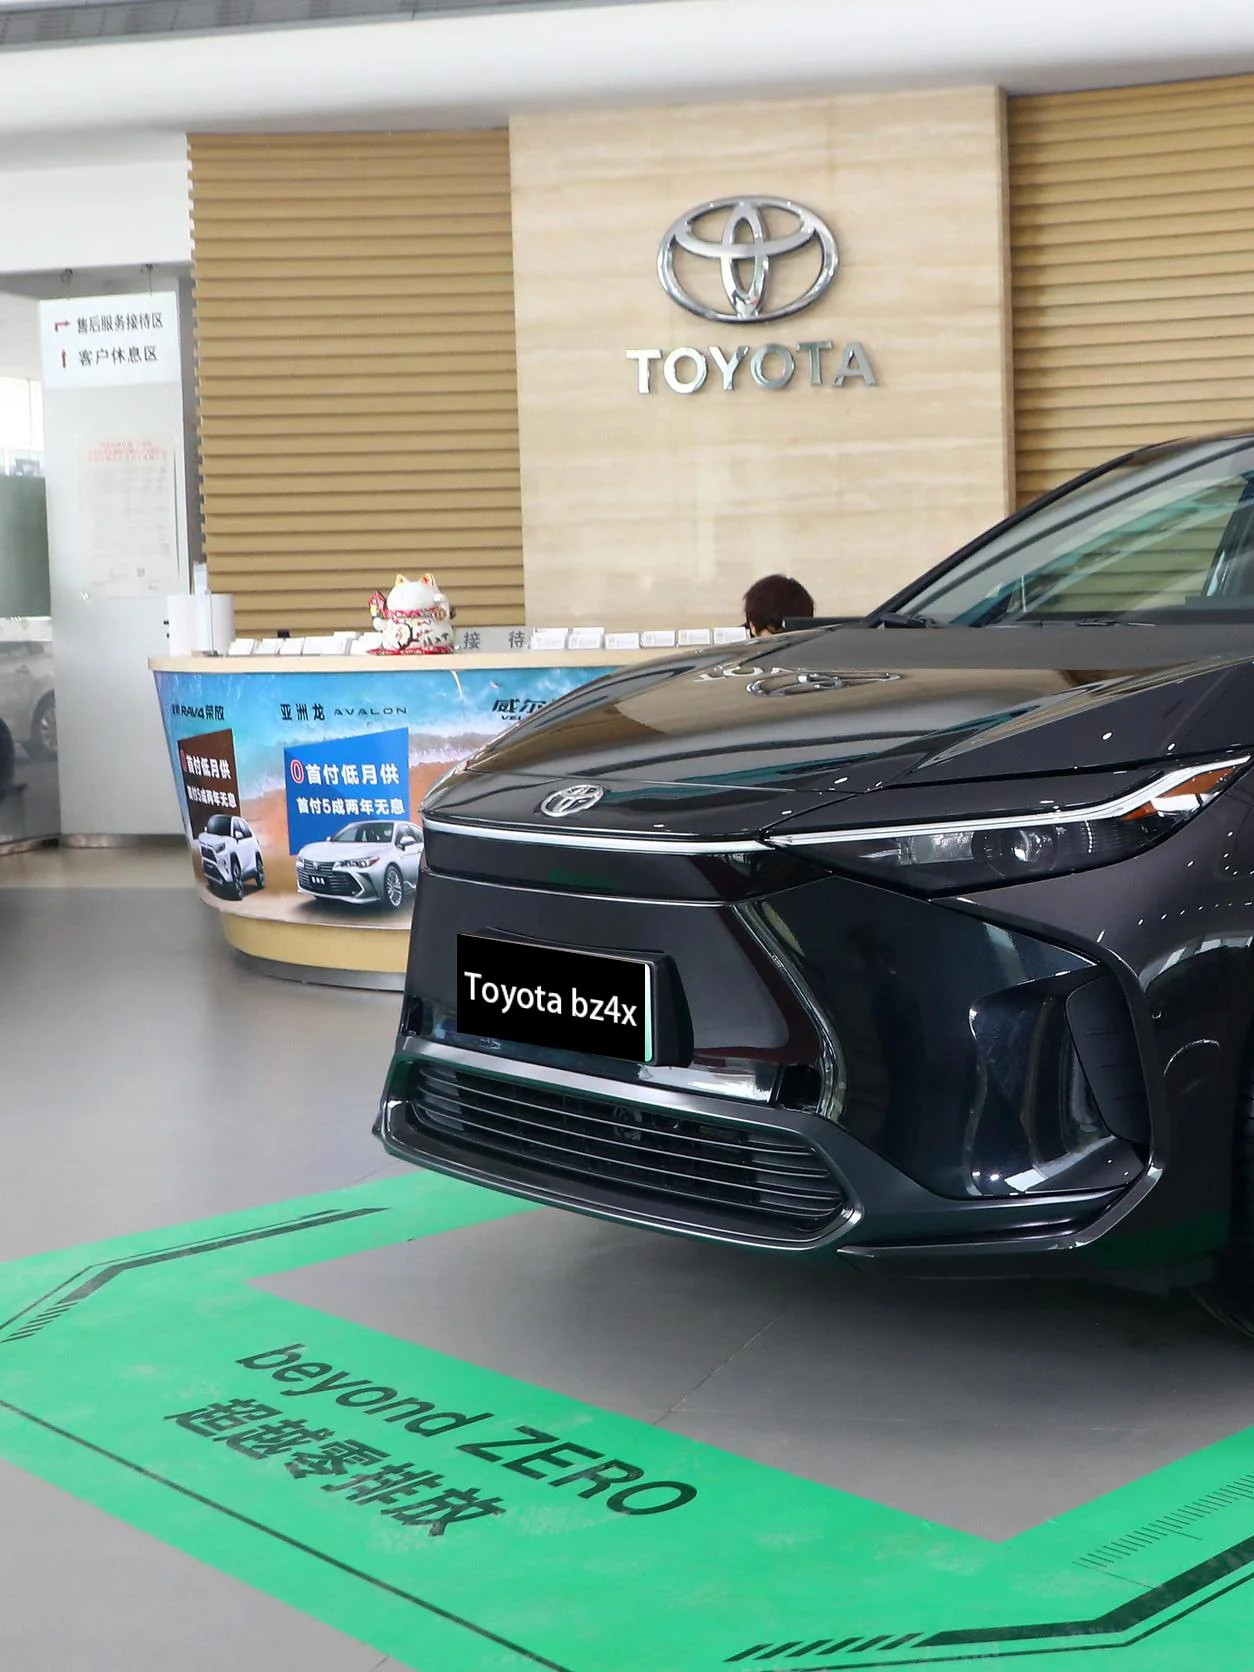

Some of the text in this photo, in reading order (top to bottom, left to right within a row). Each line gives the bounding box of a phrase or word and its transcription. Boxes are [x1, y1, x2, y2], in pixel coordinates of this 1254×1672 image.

[76, 312, 163, 334] 售后服务接待区
[79, 345, 159, 367] 客户休息区
[625, 340, 878, 395] TOYOTA
[280, 703, 408, 721] 亚洲龙 AVALON
[290, 758, 400, 785] 0首付低月供
[186, 784, 238, 809] 首付5成两年无息
[296, 797, 406, 816] 首付5成两年无息
[233, 1342, 699, 1516] beyond ZERO
[163, 1397, 508, 1538] 超越零排放
